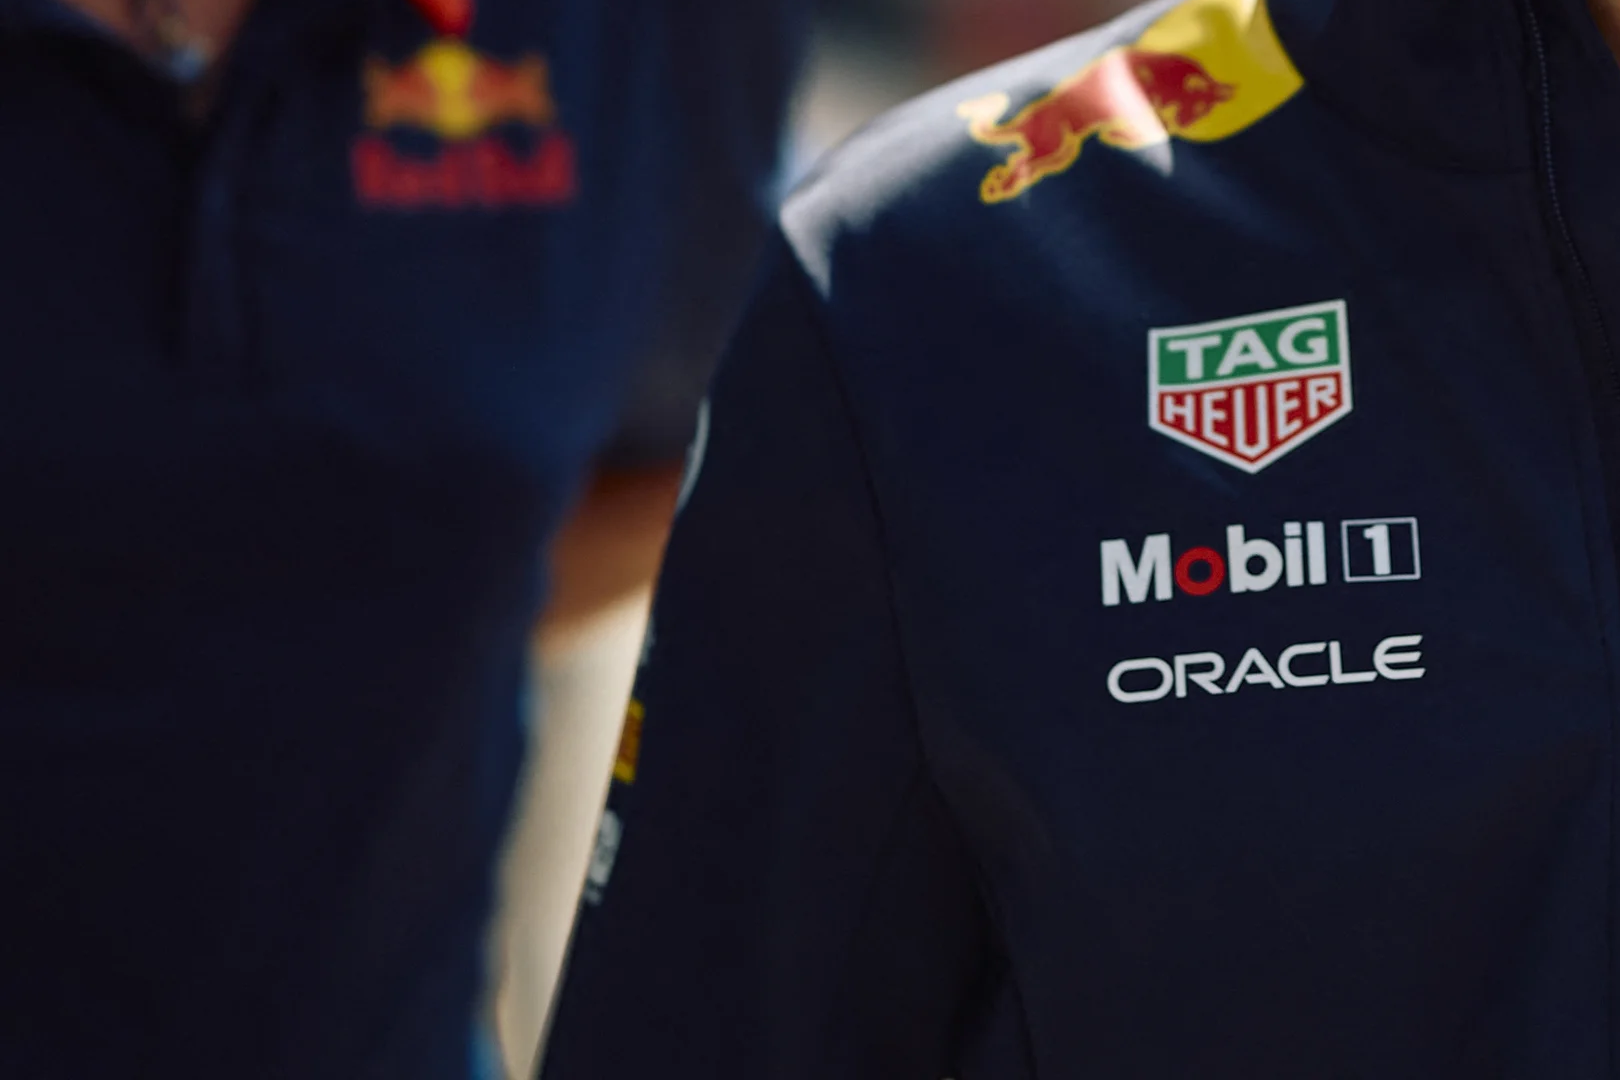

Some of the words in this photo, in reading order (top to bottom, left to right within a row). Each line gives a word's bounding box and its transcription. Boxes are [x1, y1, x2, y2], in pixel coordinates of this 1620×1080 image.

[1164, 316, 1331, 381] TAG
[1163, 376, 1340, 459] HEUER
[1099, 520, 1328, 607] Mobil
[1362, 522, 1392, 576] 1
[1105, 633, 1427, 704] ORACLE
